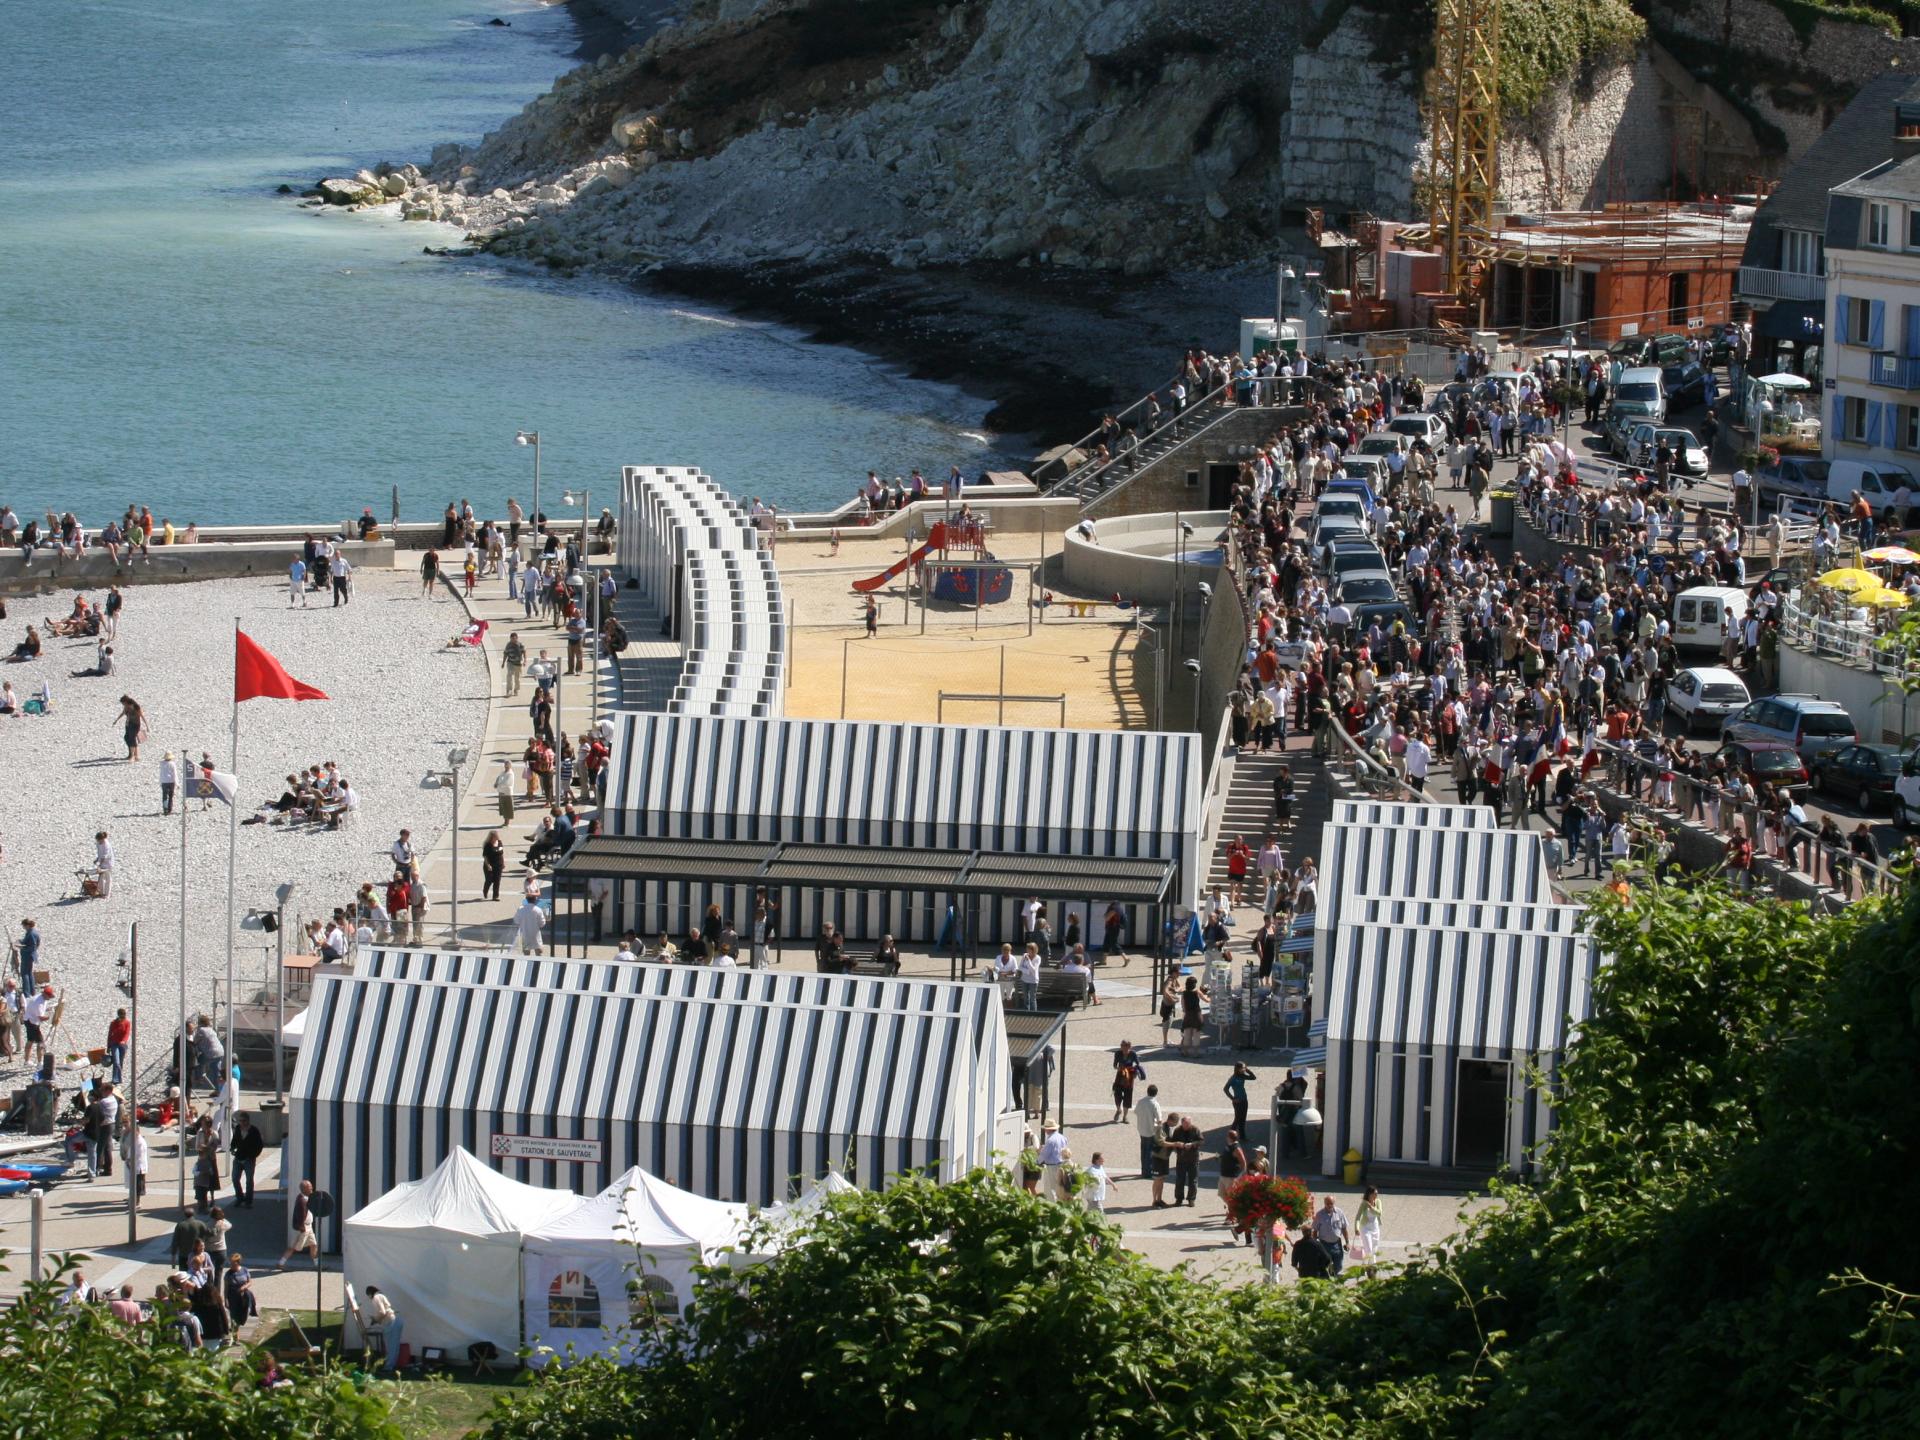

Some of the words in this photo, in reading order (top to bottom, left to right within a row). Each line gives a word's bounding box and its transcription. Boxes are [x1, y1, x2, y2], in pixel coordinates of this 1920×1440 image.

[521, 1147, 545, 1155] STATION
[546, 1148, 554, 1156] DE
[557, 1149, 593, 1158] SAUVETAGE
